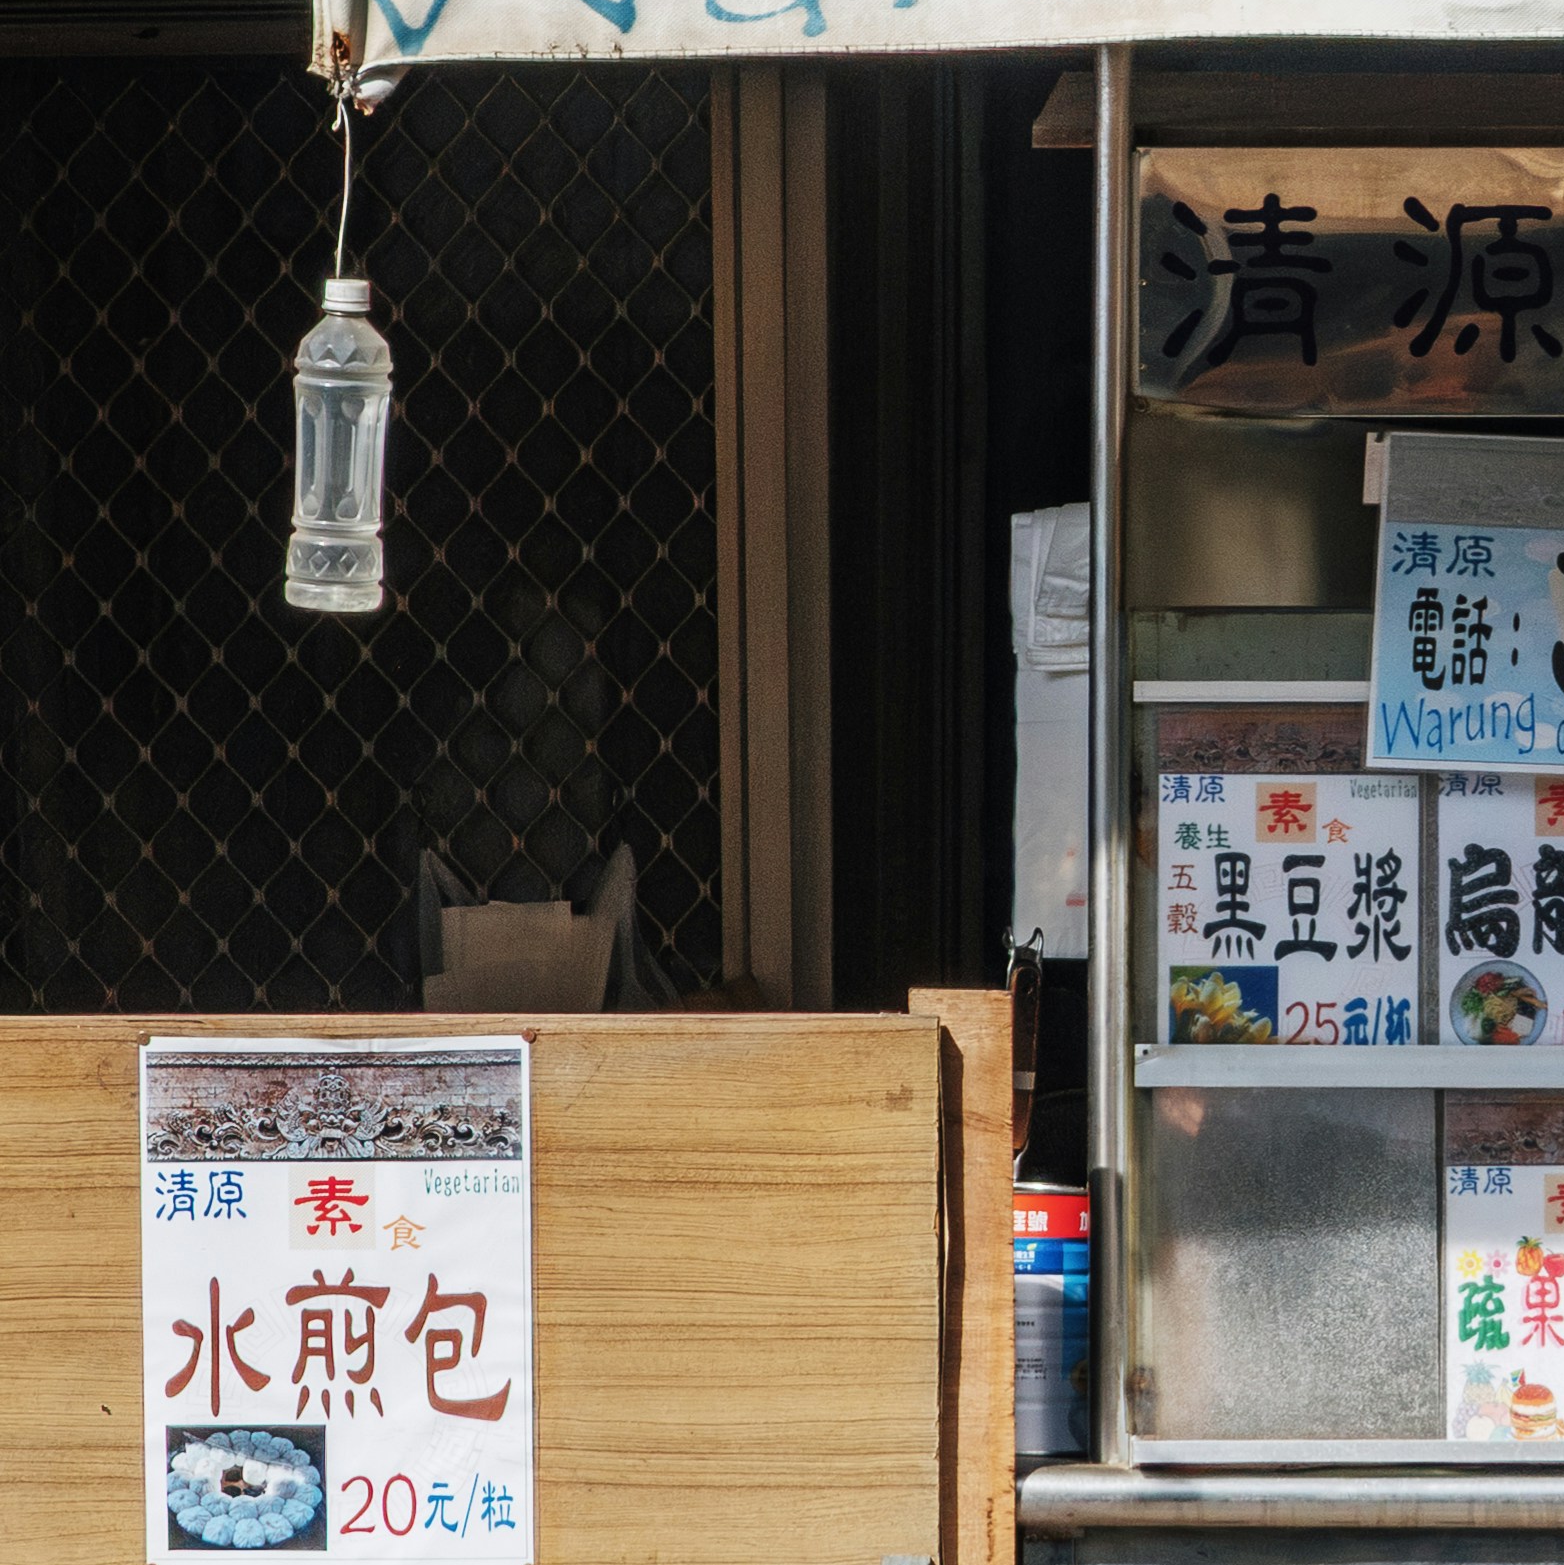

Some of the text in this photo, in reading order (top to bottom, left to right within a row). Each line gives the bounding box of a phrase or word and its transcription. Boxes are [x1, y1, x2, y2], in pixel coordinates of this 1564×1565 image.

[1392, 531, 1496, 579] 清原
[1381, 692, 1537, 755] Warung
[1162, 775, 1225, 803] 清原
[1174, 822, 1231, 850] 養生
[1167, 864, 1198, 934] 五穀
[1203, 847, 1411, 963] 黑豆漿
[155, 1170, 247, 1221] 清原
[423, 1168, 521, 1197] Vegetarian
[1450, 1167, 1513, 1195] 清原
[165, 1266, 512, 1422] 水煎包
[340, 1472, 517, 1538] 20元/粒
